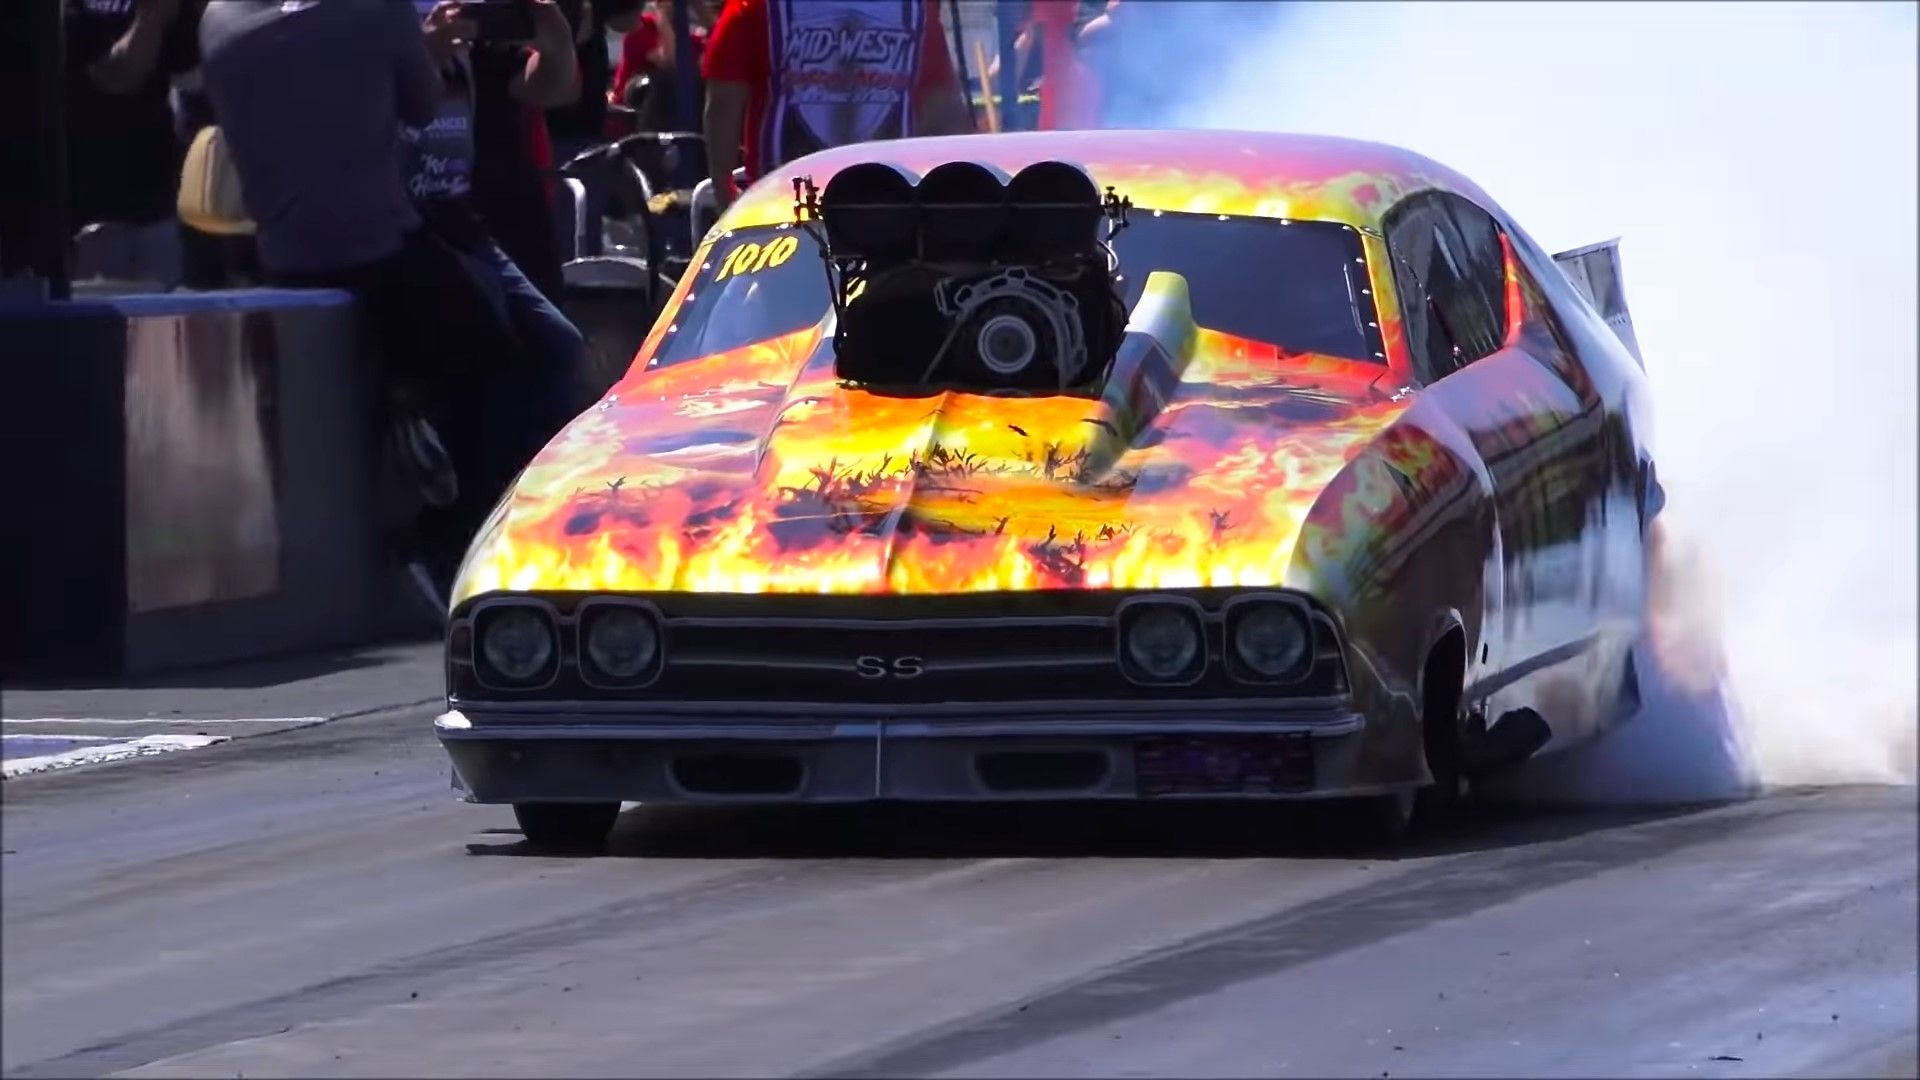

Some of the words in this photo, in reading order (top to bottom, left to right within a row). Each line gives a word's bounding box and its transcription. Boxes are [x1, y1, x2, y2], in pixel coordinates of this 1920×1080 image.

[785, 27, 911, 67] MID-WEST
[714, 235, 799, 283] 1010
[856, 655, 924, 678] SS
